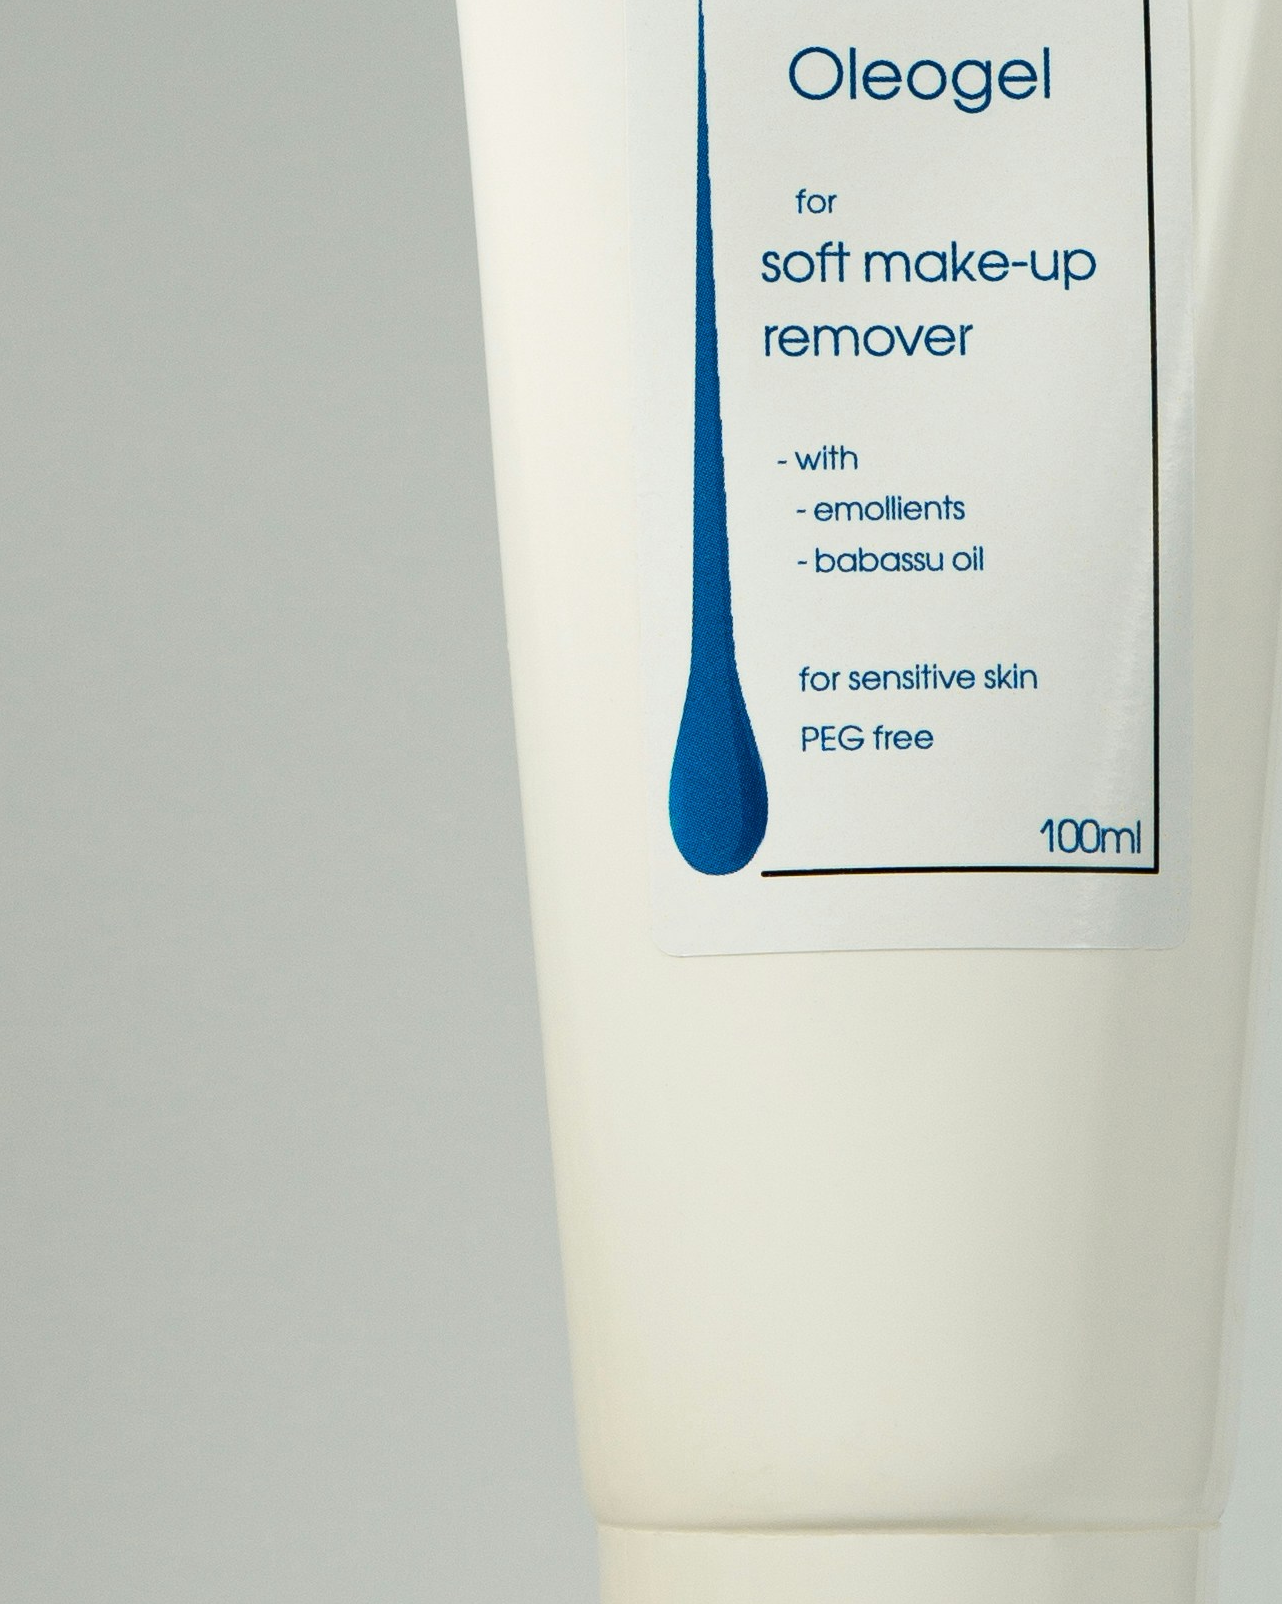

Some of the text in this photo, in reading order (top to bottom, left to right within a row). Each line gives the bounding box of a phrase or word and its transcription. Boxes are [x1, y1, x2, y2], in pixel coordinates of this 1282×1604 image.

[788, 46, 1052, 115] Oleogel
[794, 187, 838, 215] for
[760, 240, 1097, 291] soft make-up
[763, 323, 975, 358] remover
[794, 444, 859, 471] with
[813, 494, 966, 522] emollients
[814, 546, 944, 574] babassu
[951, 545, 985, 572] oil
[798, 662, 1038, 693] for sensitive skin
[801, 724, 935, 753] PEG free
[1039, 817, 1142, 855] 100ml
